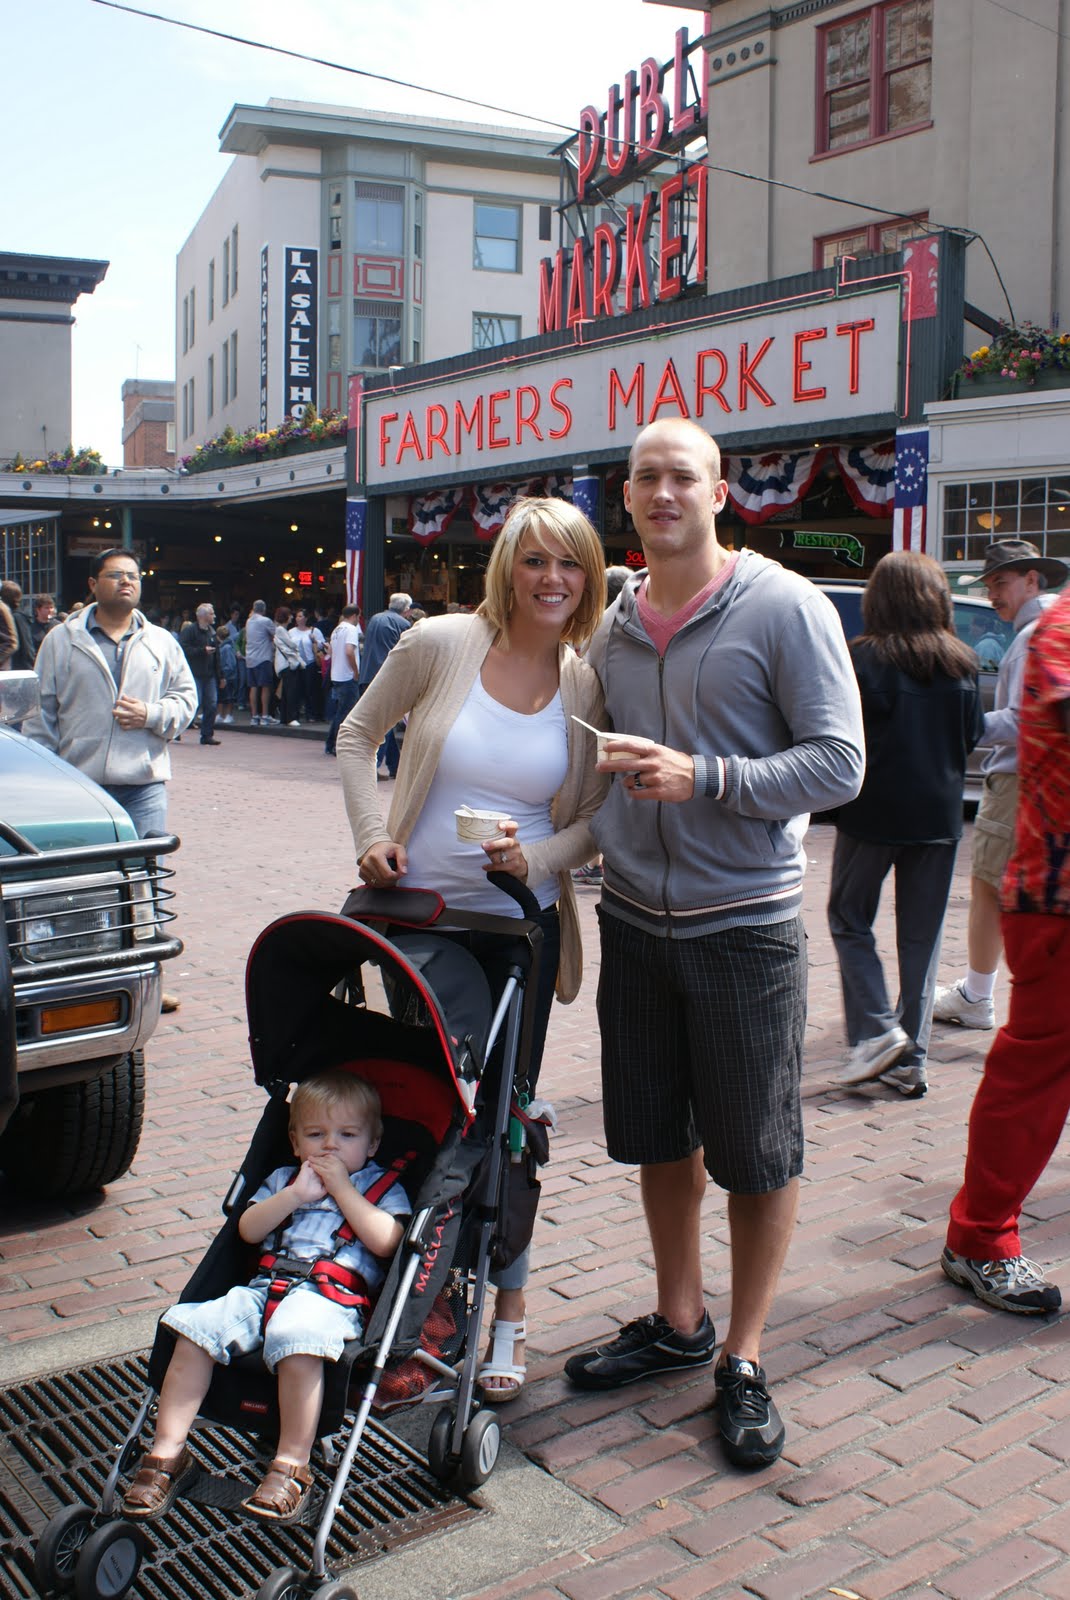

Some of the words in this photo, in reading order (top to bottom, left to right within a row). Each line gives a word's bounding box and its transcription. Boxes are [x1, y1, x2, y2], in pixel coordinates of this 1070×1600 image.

[290, 250, 312, 285] LA
[538, 158, 708, 336] MARKET
[289, 293, 311, 377] SALLE
[379, 377, 573, 467] FARMERS
[608, 318, 875, 430] MARKET
[796, 533, 860, 560] RESTROOMS
